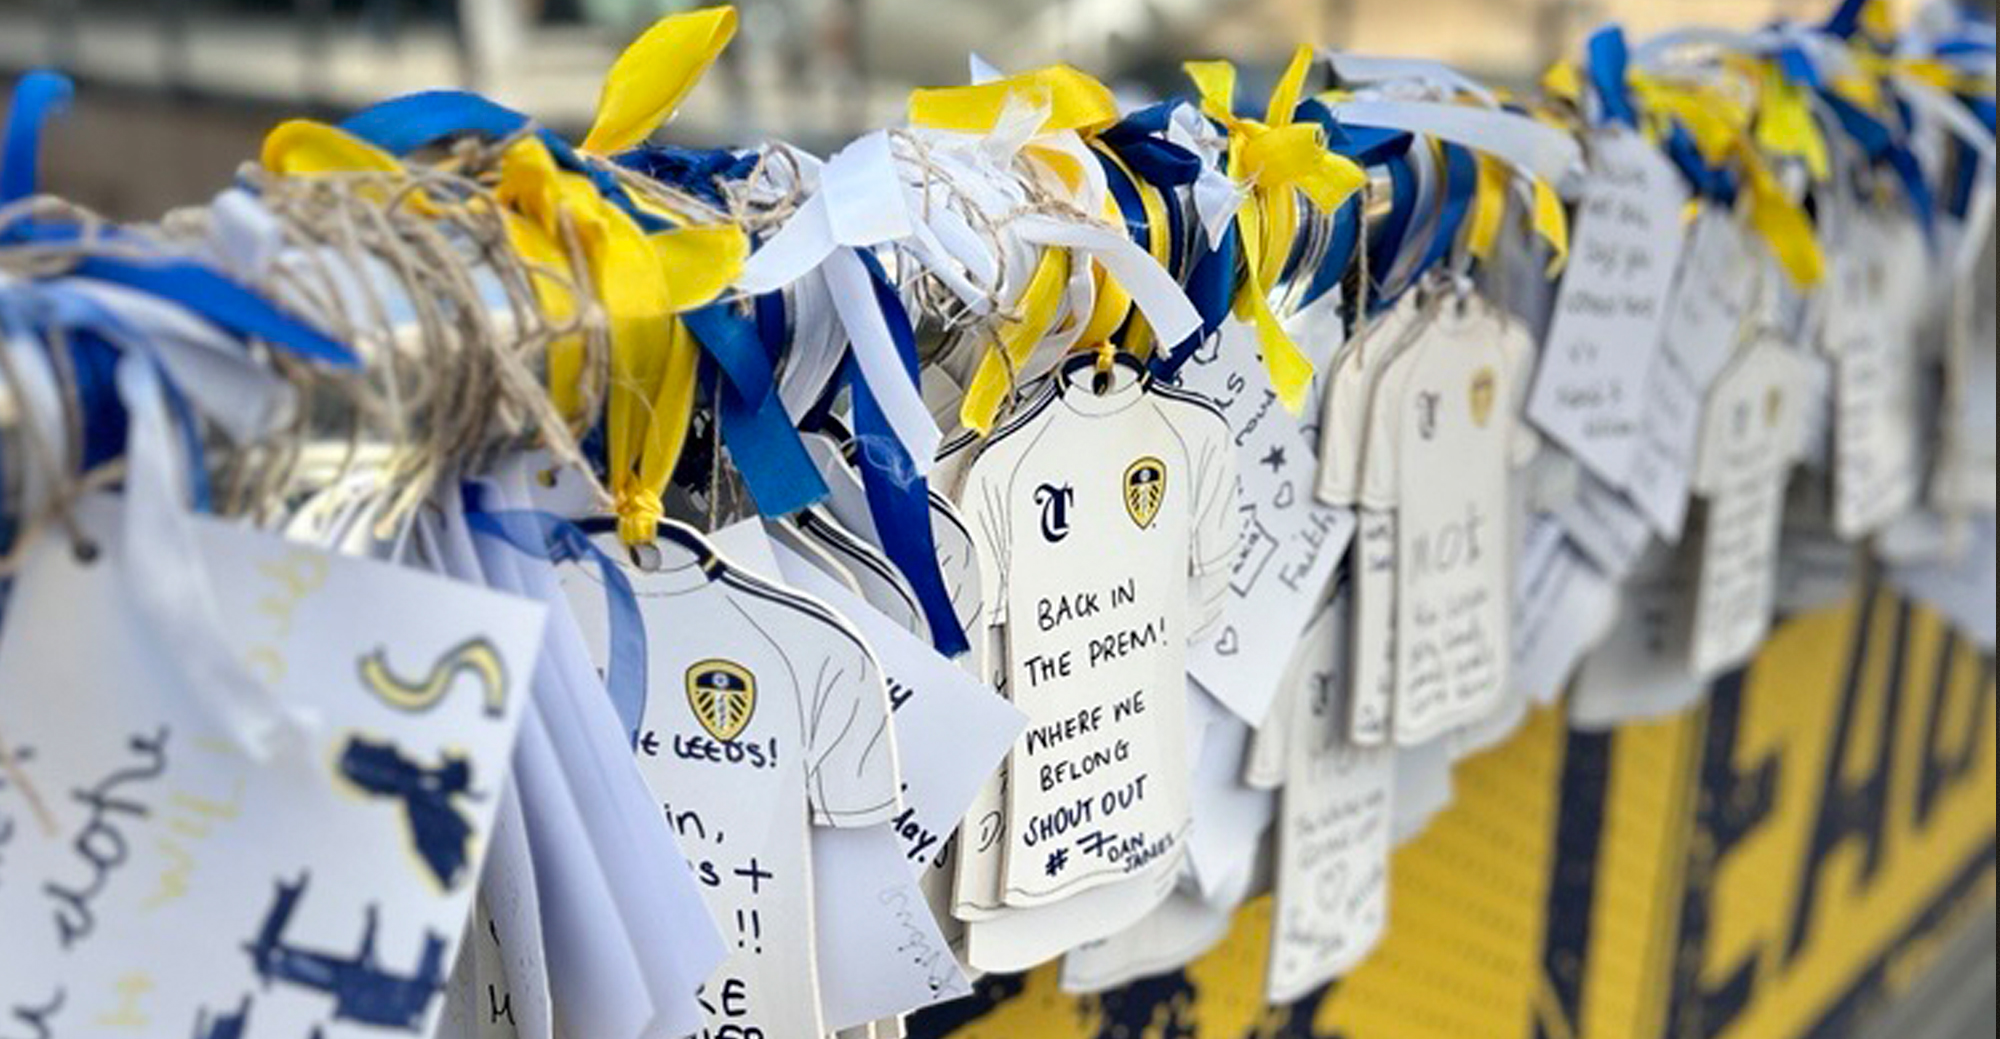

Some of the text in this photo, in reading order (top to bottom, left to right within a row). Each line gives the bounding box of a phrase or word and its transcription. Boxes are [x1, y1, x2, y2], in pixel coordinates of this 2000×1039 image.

[1037, 577, 1136, 632] BACK IN
[1023, 650, 1072, 687] THE
[1088, 616, 1168, 668] PREM!
[673, 736, 778, 769] LEEDS!
[1026, 689, 1146, 756] WHERE WE
[1039, 738, 1130, 792] BELONG
[1022, 796, 1095, 848] SHOUT
[1101, 773, 1148, 817] OUT
